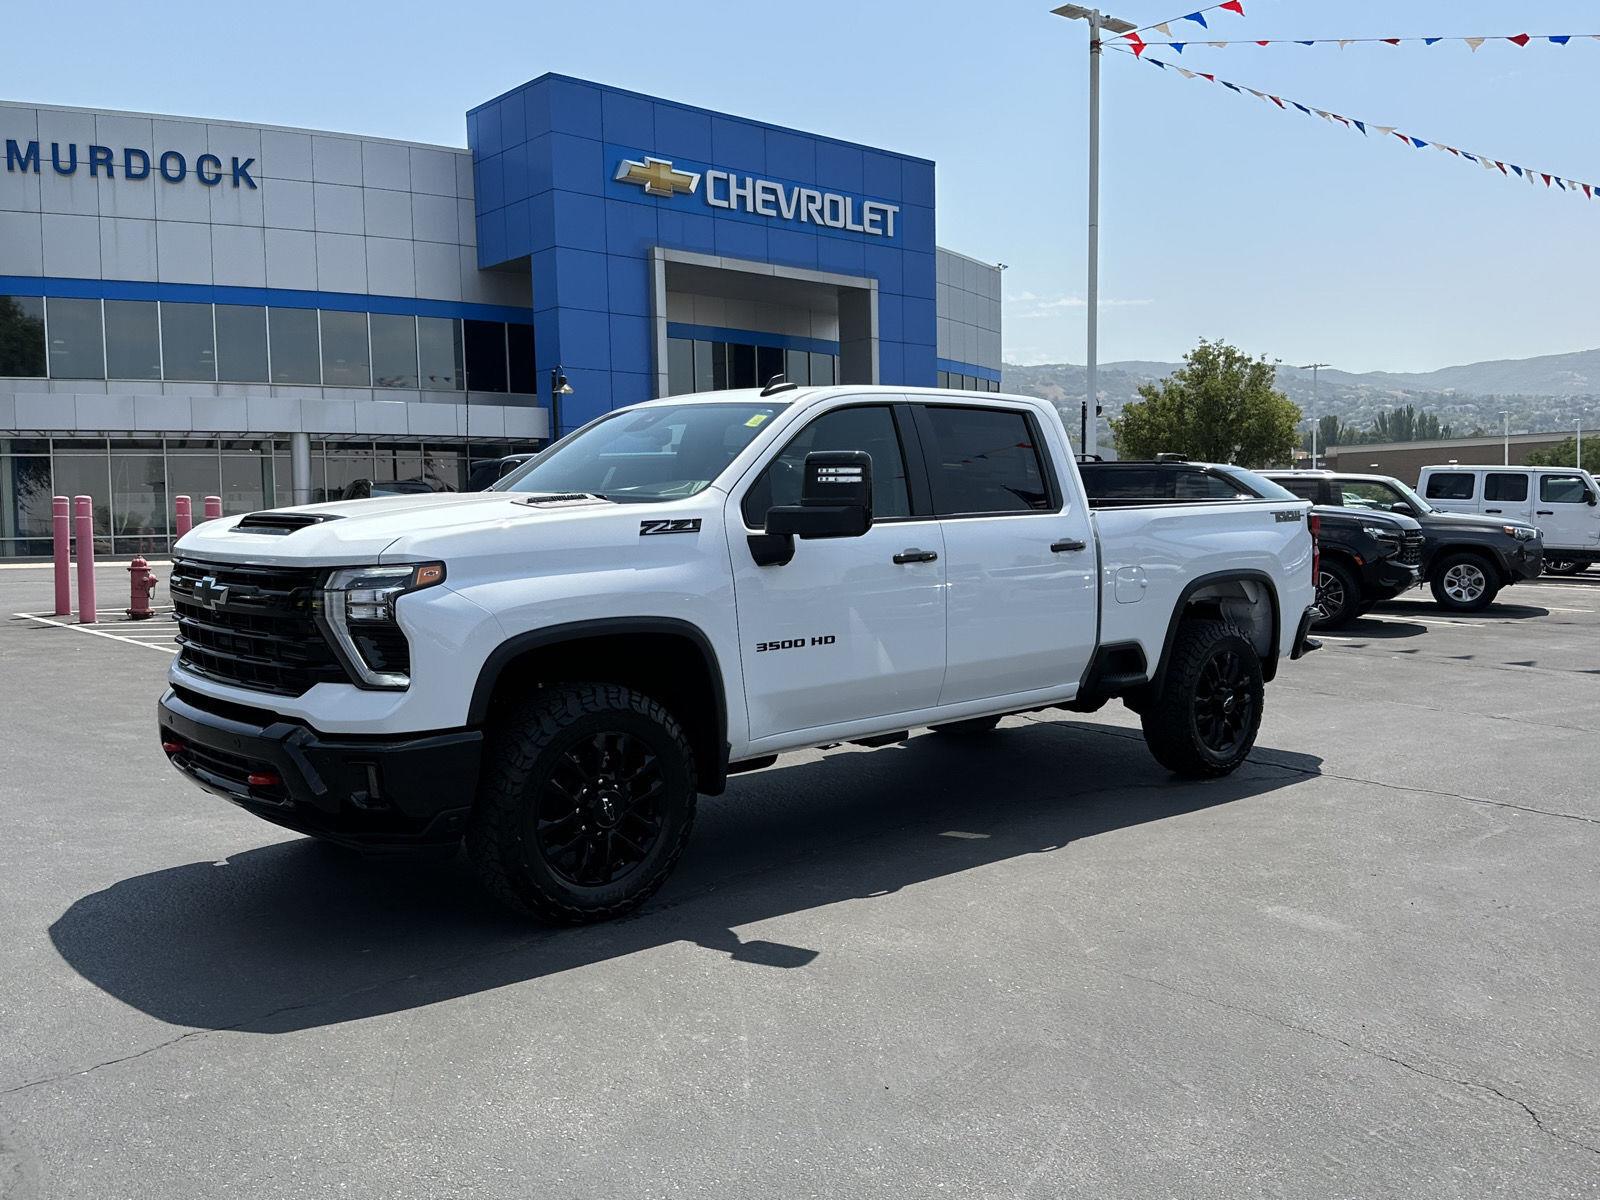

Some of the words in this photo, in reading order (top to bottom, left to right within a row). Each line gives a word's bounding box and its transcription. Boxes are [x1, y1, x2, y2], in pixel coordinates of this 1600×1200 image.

[6, 138, 258, 190] MURDOCK
[705, 169, 900, 237] CHEVROLET
[756, 638, 805, 652] 3500
[811, 635, 836, 646] HD
